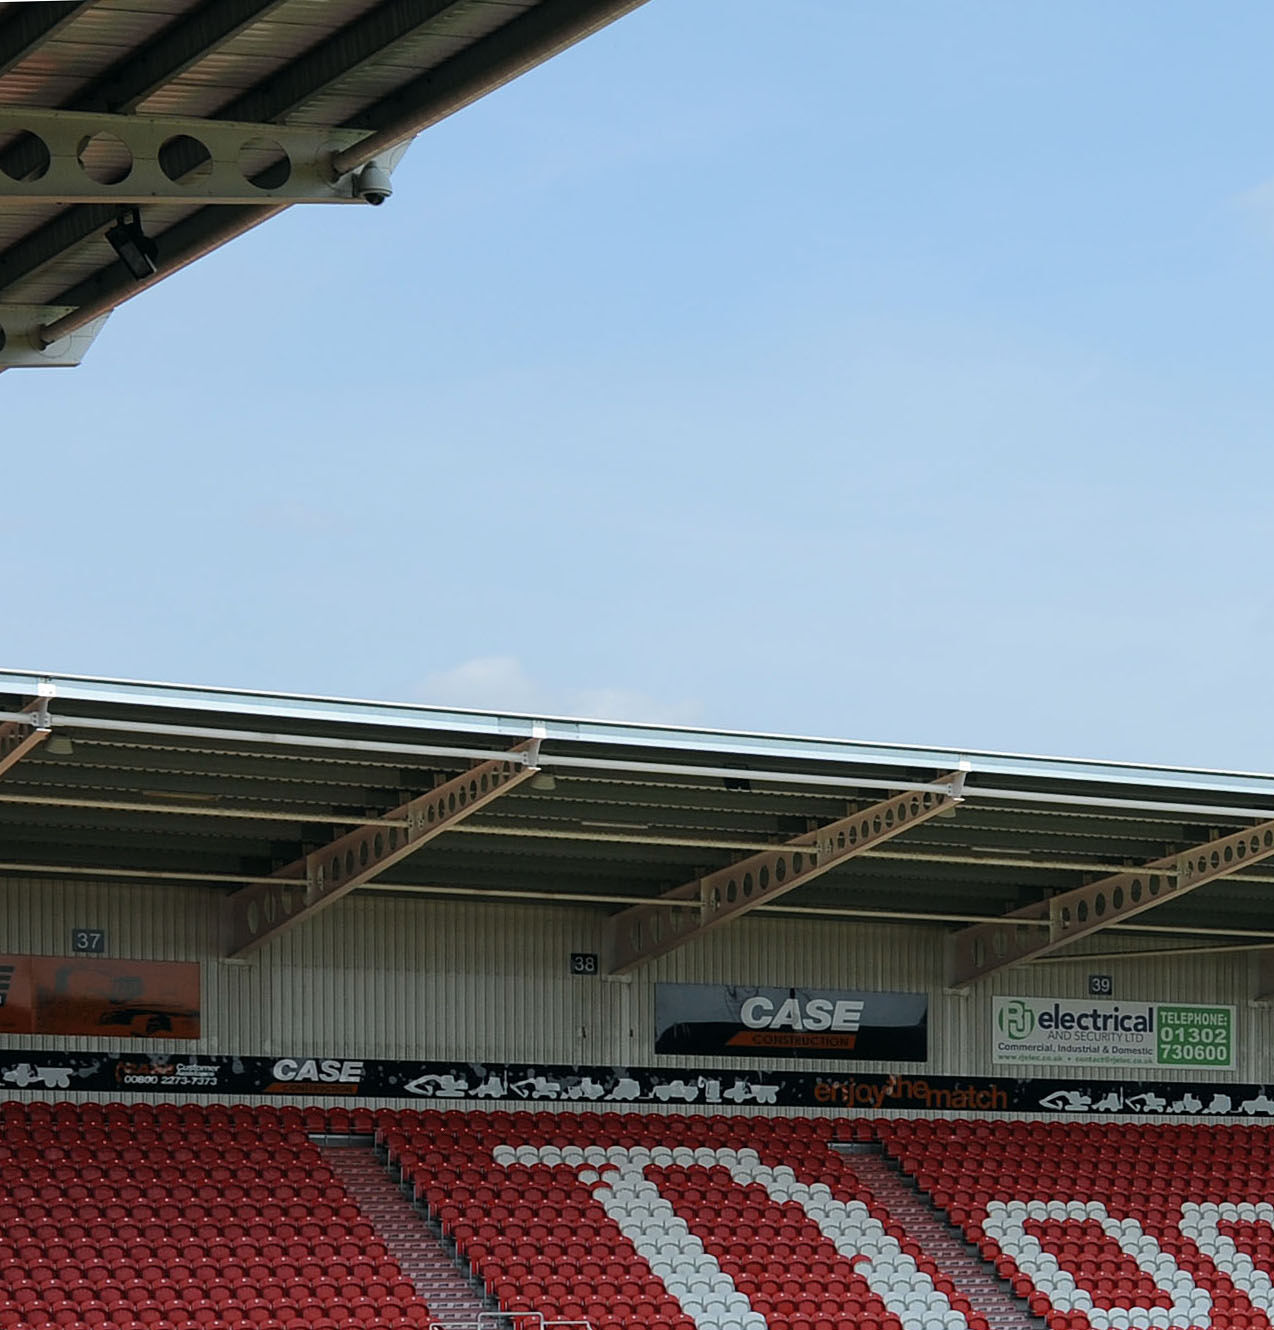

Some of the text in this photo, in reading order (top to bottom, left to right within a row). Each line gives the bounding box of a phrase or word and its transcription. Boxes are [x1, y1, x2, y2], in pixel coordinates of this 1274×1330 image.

[77, 932, 101, 949] 37
[575, 957, 596, 972] 38
[1092, 979, 1110, 993] 39
[740, 996, 865, 1032] CASE
[1038, 1003, 1154, 1033] electrical
[1160, 1011, 1228, 1027] TELEPHONE:
[752, 1033, 850, 1047] CONSTRUCTION
[1047, 1030, 1145, 1044] AND SECURITY LTD
[1160, 1027, 1227, 1044] 01302
[1057, 1044, 1099, 1055] Industrial
[1102, 1045, 1109, 1055] &
[1111, 1046, 1153, 1057] Domestic
[1160, 1044, 1228, 1062] 730600
[124, 1074, 158, 1085] 00800
[273, 1059, 364, 1084] CASE
[814, 1074, 1008, 1110] enjoy the match
